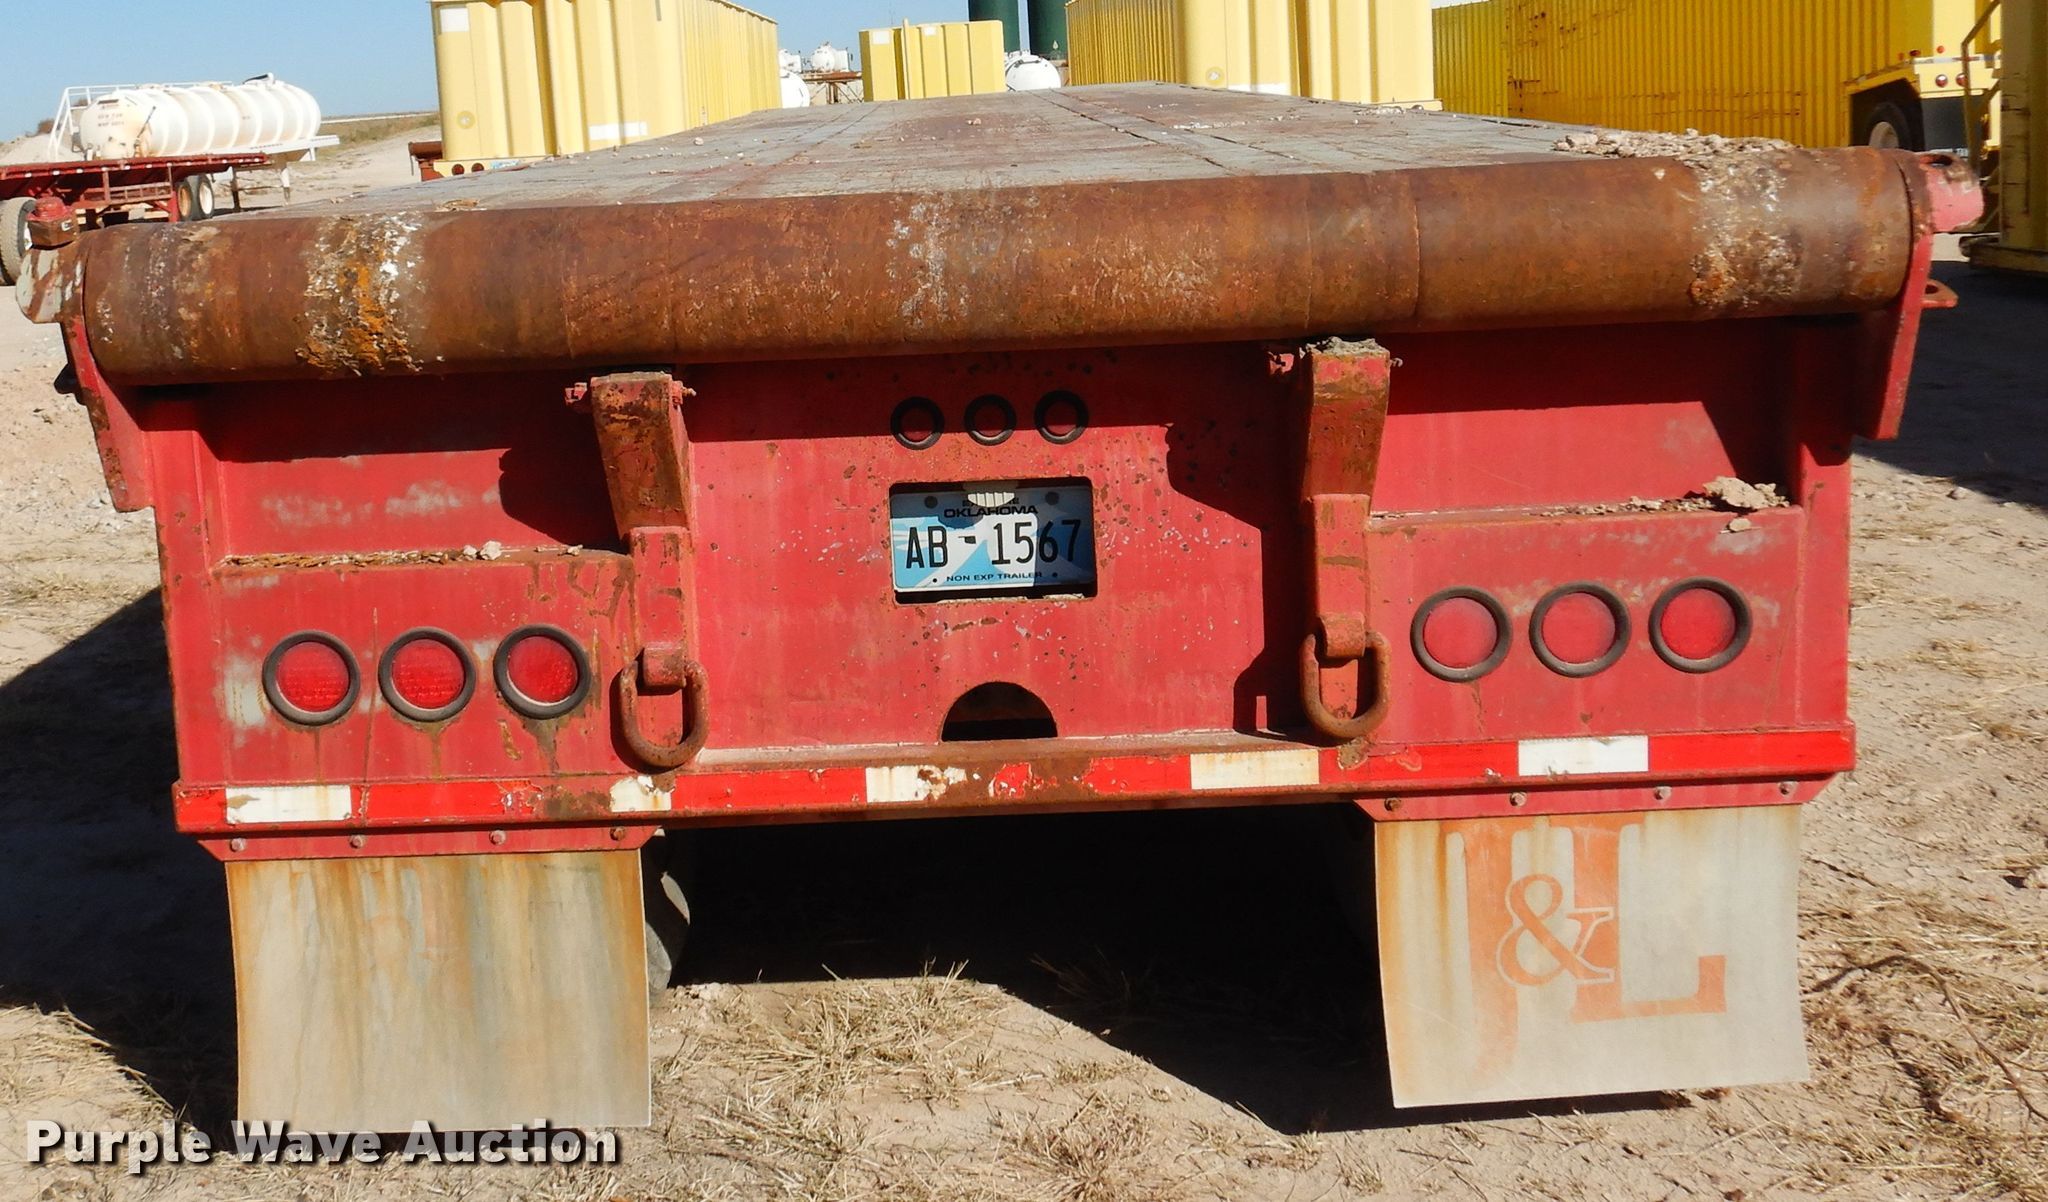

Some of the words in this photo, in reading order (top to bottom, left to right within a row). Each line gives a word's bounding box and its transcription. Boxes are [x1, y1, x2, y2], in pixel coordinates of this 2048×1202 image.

[944, 505, 1038, 518] OKLAHOMA
[906, 526, 948, 568] AB
[991, 519, 1081, 565] 1567
[946, 574, 969, 582] NON
[973, 573, 994, 581] EXP
[997, 571, 1042, 580] TRAILER
